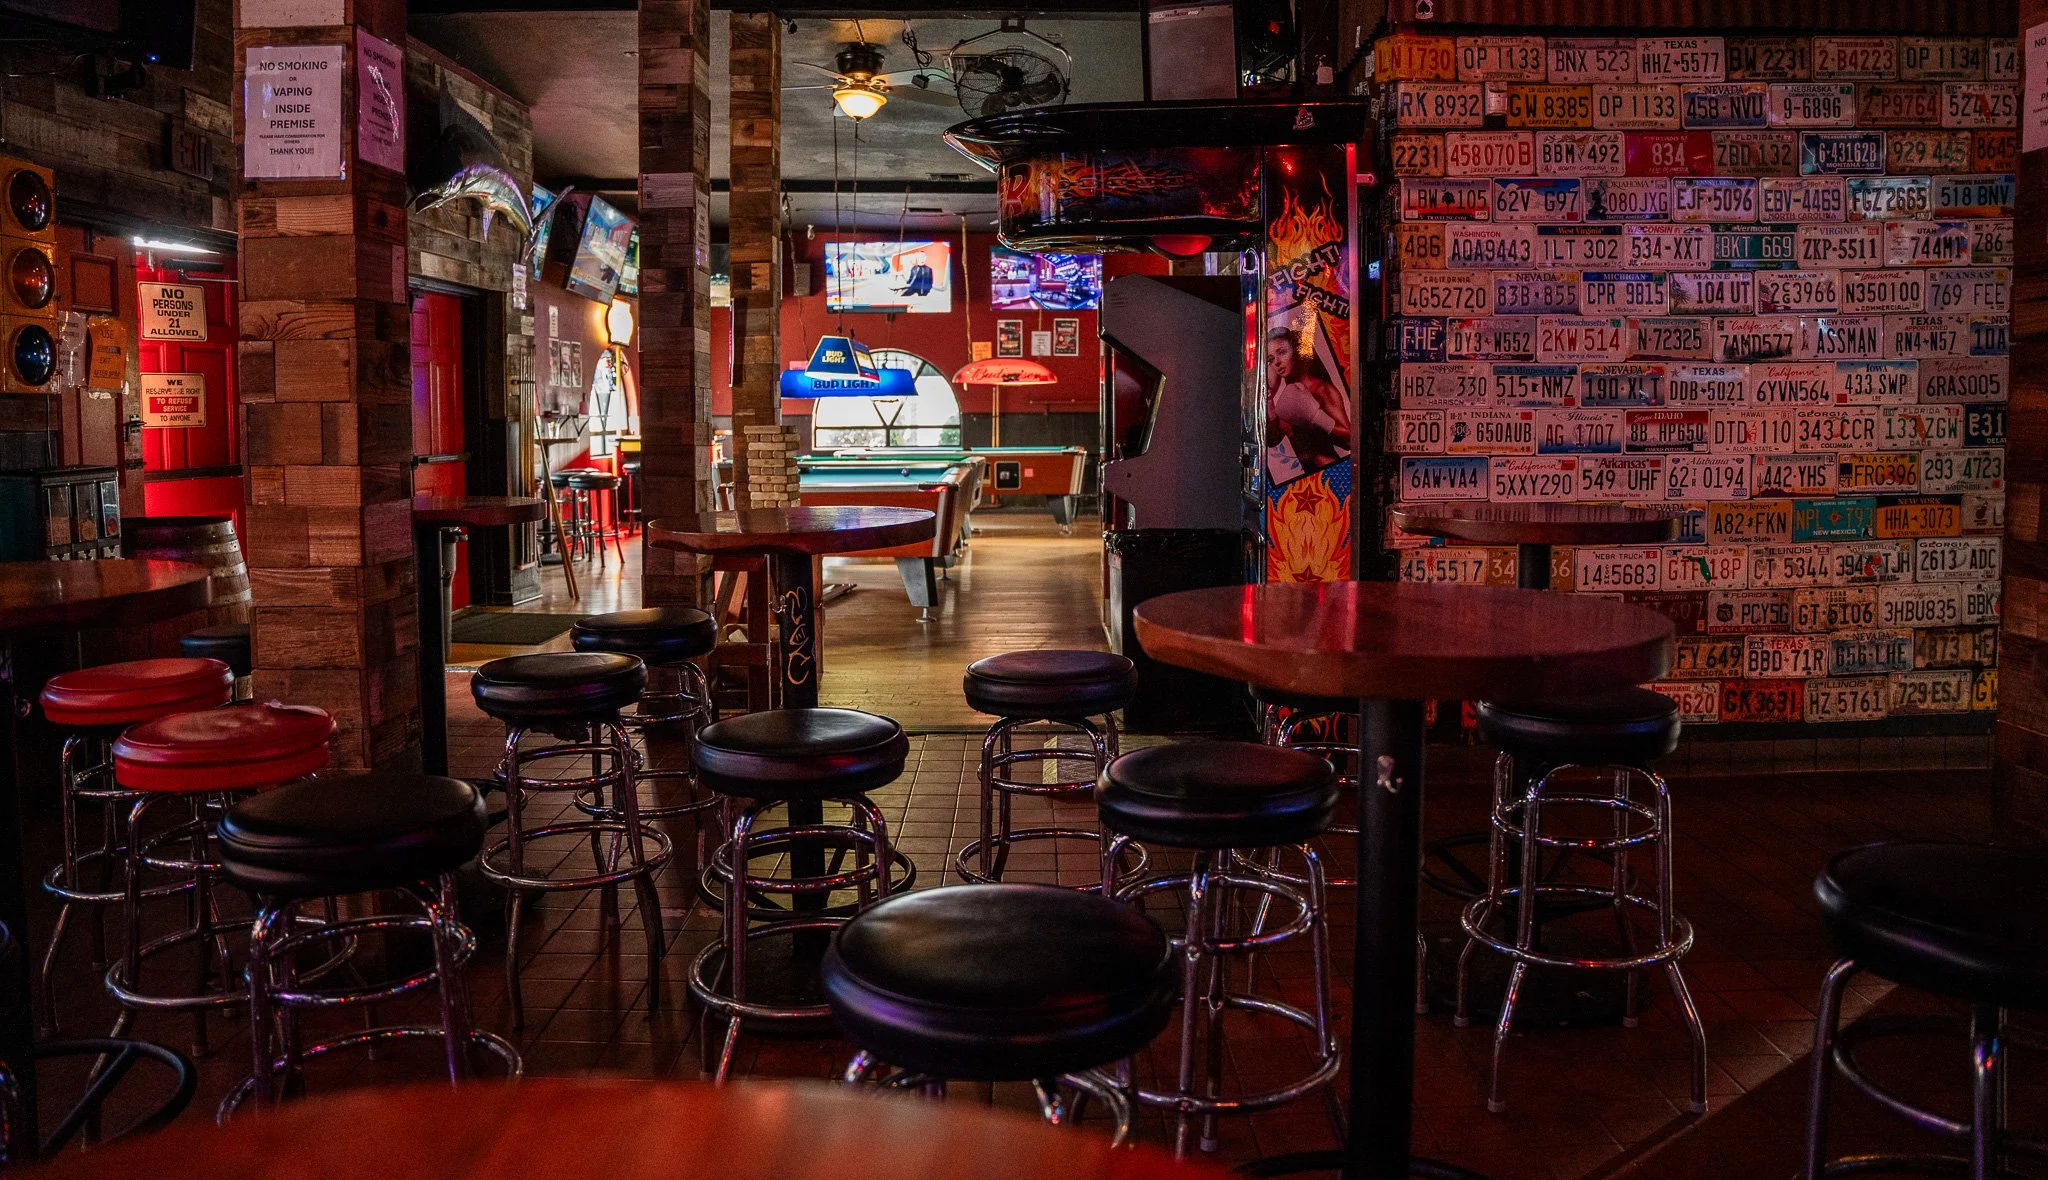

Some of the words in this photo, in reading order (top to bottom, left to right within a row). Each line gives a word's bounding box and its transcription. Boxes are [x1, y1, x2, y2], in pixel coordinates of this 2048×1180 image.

[1664, 41, 1697, 49] TEXAS
[2034, 37, 2046, 48] NO
[259, 62, 275, 71] NO
[277, 61, 328, 71] SMOKING
[1464, 47, 1487, 69] OP
[1498, 47, 1540, 69] 1133
[1555, 50, 1588, 72] BNX
[1596, 51, 1630, 71] 523
[273, 87, 312, 96] VAPING
[1705, 86, 1744, 94] NEVADA
[275, 104, 311, 113] INSIDE
[1400, 93, 1428, 118] RK
[1435, 94, 1480, 117] 8932
[1509, 94, 1537, 118] GW
[1543, 96, 1589, 119] 8385
[1600, 95, 1622, 117] OP
[1632, 95, 1674, 117] 1133
[270, 119, 315, 129] PREMISE
[1395, 145, 1439, 168] 2231
[1543, 144, 1575, 163] BBM
[1588, 144, 1619, 163] 492
[1652, 142, 1685, 166] 834
[1407, 189, 1438, 209] LBW
[1458, 189, 1487, 209] 105
[1497, 191, 1531, 211] 62V
[1544, 191, 1578, 211] G97
[1941, 187, 1971, 206] 518
[1977, 186, 2009, 206] BNV
[1820, 226, 1860, 235] VIRGINIA
[1721, 236, 1750, 257] BKT
[1762, 236, 1792, 257] 669
[1268, 244, 1342, 291] FIGHT!
[1516, 273, 1557, 281] NEVADA
[1945, 271, 1990, 279] KANSAS
[161, 288, 184, 299] NO
[1296, 284, 1350, 317] FIGHT!
[1408, 287, 1486, 309] 4G52720
[1588, 283, 1615, 305] CPR
[1626, 282, 1663, 304] 9815
[1696, 282, 1723, 304] 104
[1731, 281, 1749, 303] UT
[1845, 282, 1919, 302] N350100
[1931, 284, 1962, 306] 769
[1974, 284, 2004, 304] FEE
[152, 299, 193, 310] PERSONS
[157, 310, 190, 318] UNDER
[169, 318, 181, 328] 21
[1910, 317, 1943, 325] TEXAS
[151, 328, 198, 336] ALLOWED
[1542, 330, 1578, 351] 2KW
[1584, 329, 1619, 351] 514
[1817, 328, 1876, 353] ASSMAN
[822, 356, 846, 364] LIGHT
[1603, 366, 1643, 374] NEVADA
[813, 380, 839, 389] BUD
[1405, 377, 1435, 397] HBZ
[1457, 377, 1486, 397] 330
[1496, 377, 1528, 397] 515
[1542, 376, 1574, 397] NMZ
[1757, 380, 1829, 400] 6YVN564
[1845, 374, 1872, 395] 433
[1880, 374, 1907, 395] SWP
[1926, 374, 2000, 397] 6RAS005
[1653, 412, 1683, 420] IDAHO
[1406, 423, 1440, 443] 200
[1476, 423, 1531, 442] 650AUB
[1545, 424, 1563, 446] AG
[1576, 424, 1614, 445] 1707
[1715, 421, 1747, 443] DTD
[1761, 420, 1791, 443] 110
[1799, 419, 1833, 441] 343
[1840, 419, 1874, 440] CCR
[1508, 460, 1560, 473] California
[1598, 458, 1647, 469] Arkansas
[1925, 459, 1953, 480] 293
[1963, 458, 2001, 479] 4723
[1583, 470, 1615, 490] 549
[1628, 470, 1661, 490] UHF
[1854, 464, 1916, 486] FRG396
[1496, 475, 1572, 496] 5XXY290
[1714, 513, 1744, 535] A82
[1755, 512, 1786, 534] FKN
[1885, 508, 1909, 529] HHA
[1920, 508, 1953, 529] 3073
[1768, 546, 1812, 555] ILLINOIS
[1921, 551, 1957, 570] 2613
[1970, 549, 1996, 569] ADC
[1754, 558, 1777, 580] CT
[1784, 556, 1828, 578] 5344
[1884, 599, 1956, 622] 3HBU835
[1771, 640, 1803, 649] TEXAS
[1823, 680, 1866, 688] ILLINOIS
